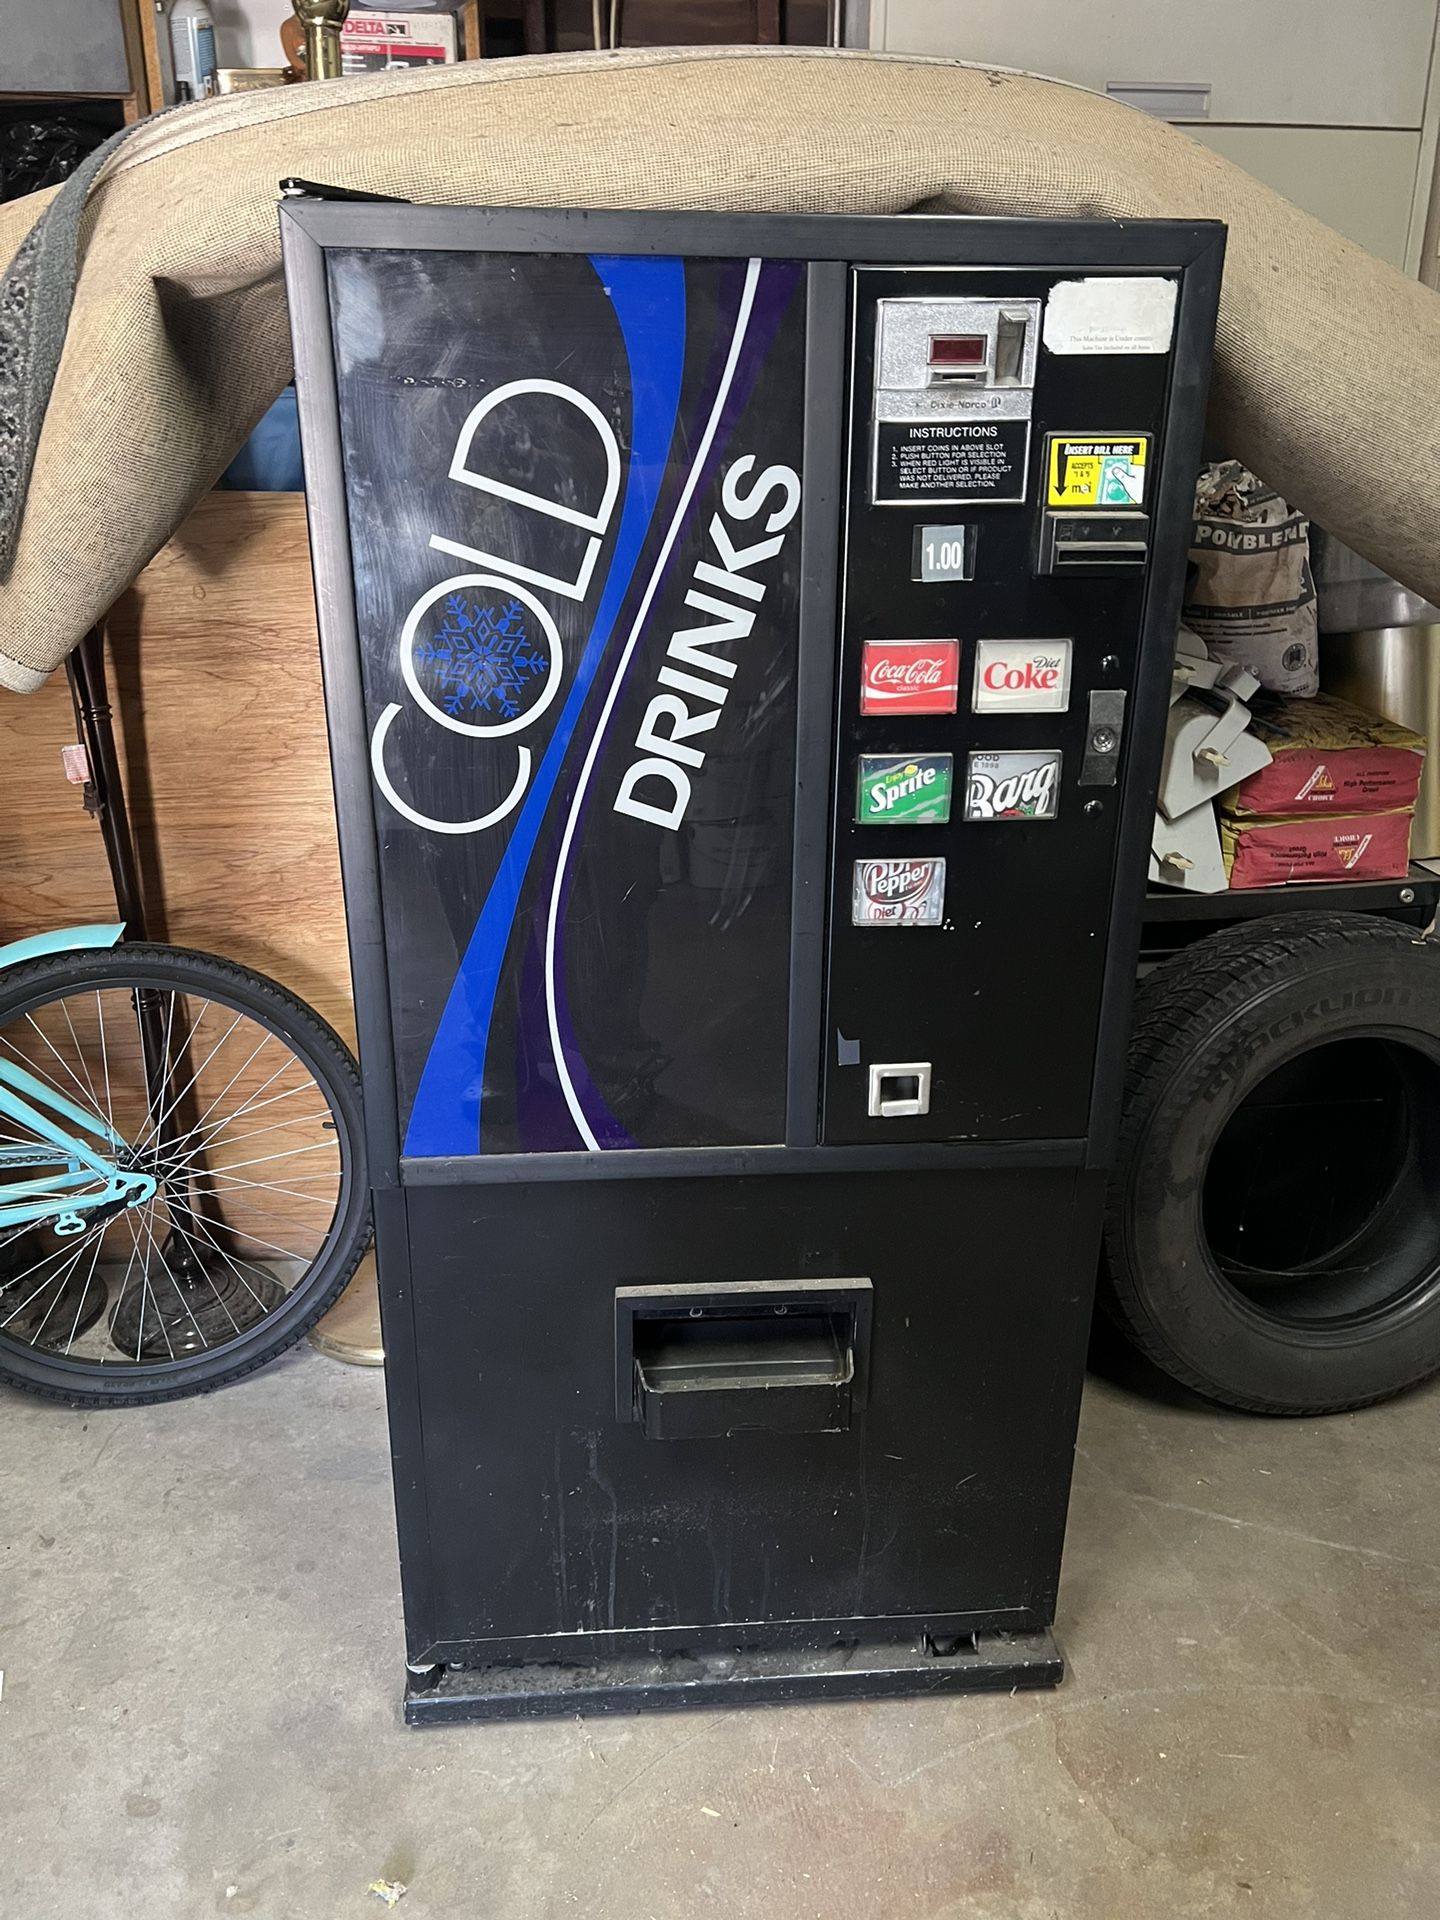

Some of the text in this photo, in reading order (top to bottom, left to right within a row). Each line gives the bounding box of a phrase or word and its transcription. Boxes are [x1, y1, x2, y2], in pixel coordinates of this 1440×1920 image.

[344, 20, 386, 34] DELTA
[909, 426, 998, 438] INSTRUCTIONS
[1064, 443, 1093, 456] INSERT
[1094, 445, 1111, 454] BILL
[1112, 445, 1134, 454] HERE
[1072, 482, 1092, 494] mei
[926, 541, 961, 570] 1.00
[370, 378, 620, 835] COLD
[613, 454, 801, 831] DRINKS
[1033, 656, 1060, 668] Diet
[870, 658, 947, 684] Coca-Cola
[984, 662, 1058, 690] Coke
[896, 684, 920, 692] classic
[885, 772, 904, 784] Enjoy
[869, 767, 936, 813] Sprite
[1334, 834, 1360, 843] CHOICE
[870, 863, 930, 896] Pepper
[874, 906, 896, 919] Diet
